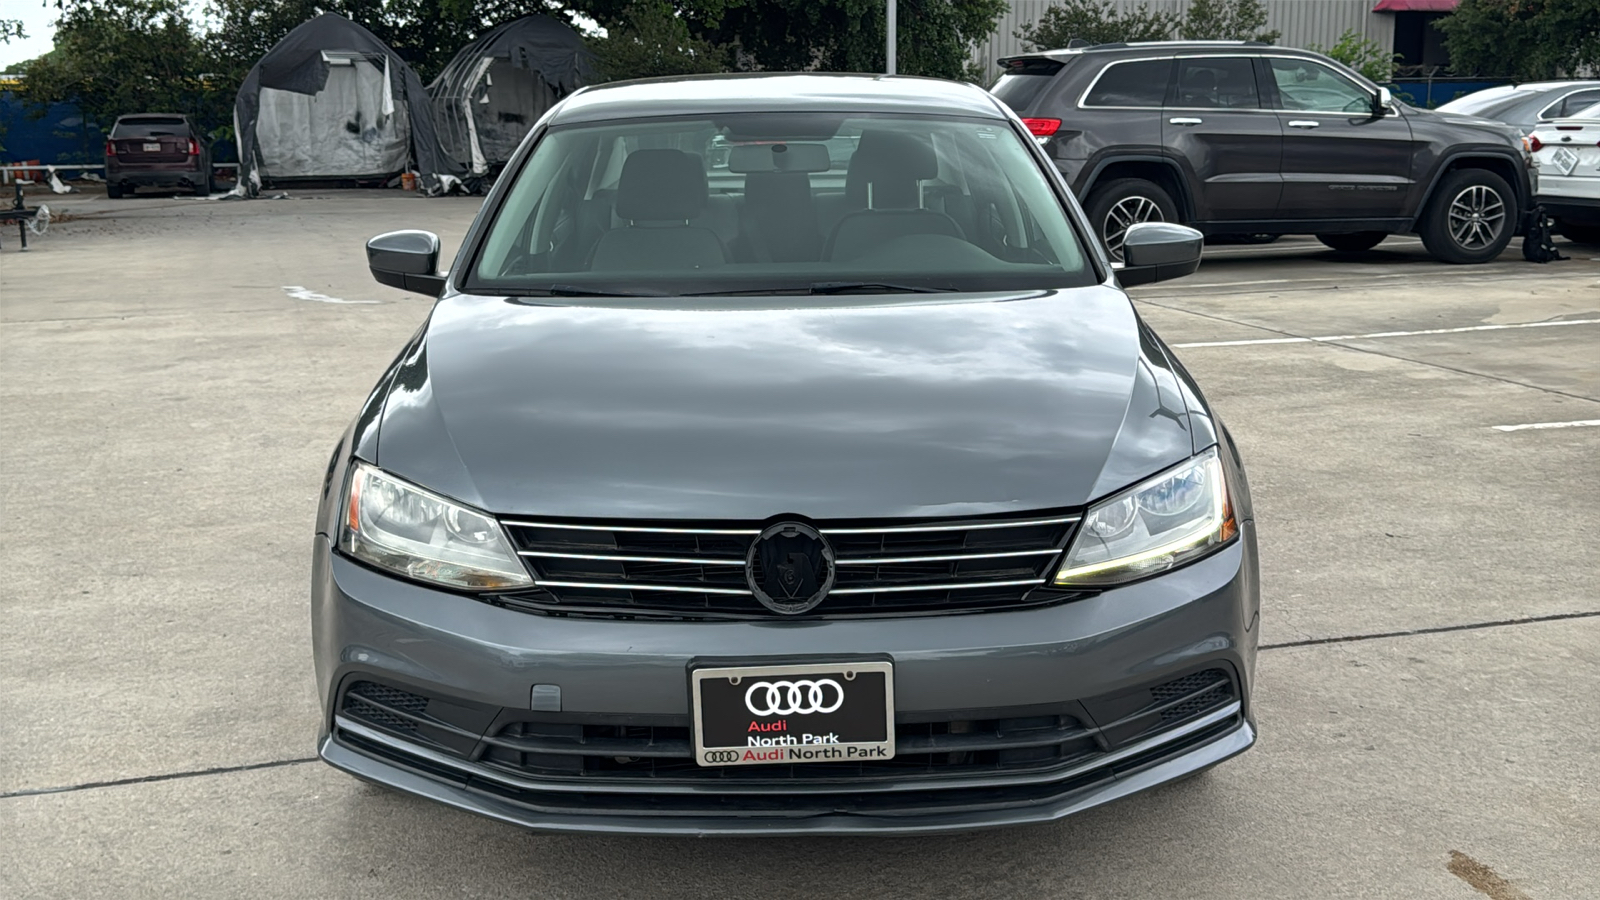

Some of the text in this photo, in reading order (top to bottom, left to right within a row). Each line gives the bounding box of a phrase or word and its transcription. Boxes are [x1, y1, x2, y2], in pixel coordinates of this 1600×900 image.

[748, 720, 787, 732] Audi
[747, 732, 839, 747] North Park
[743, 746, 887, 761] Audi North Park
